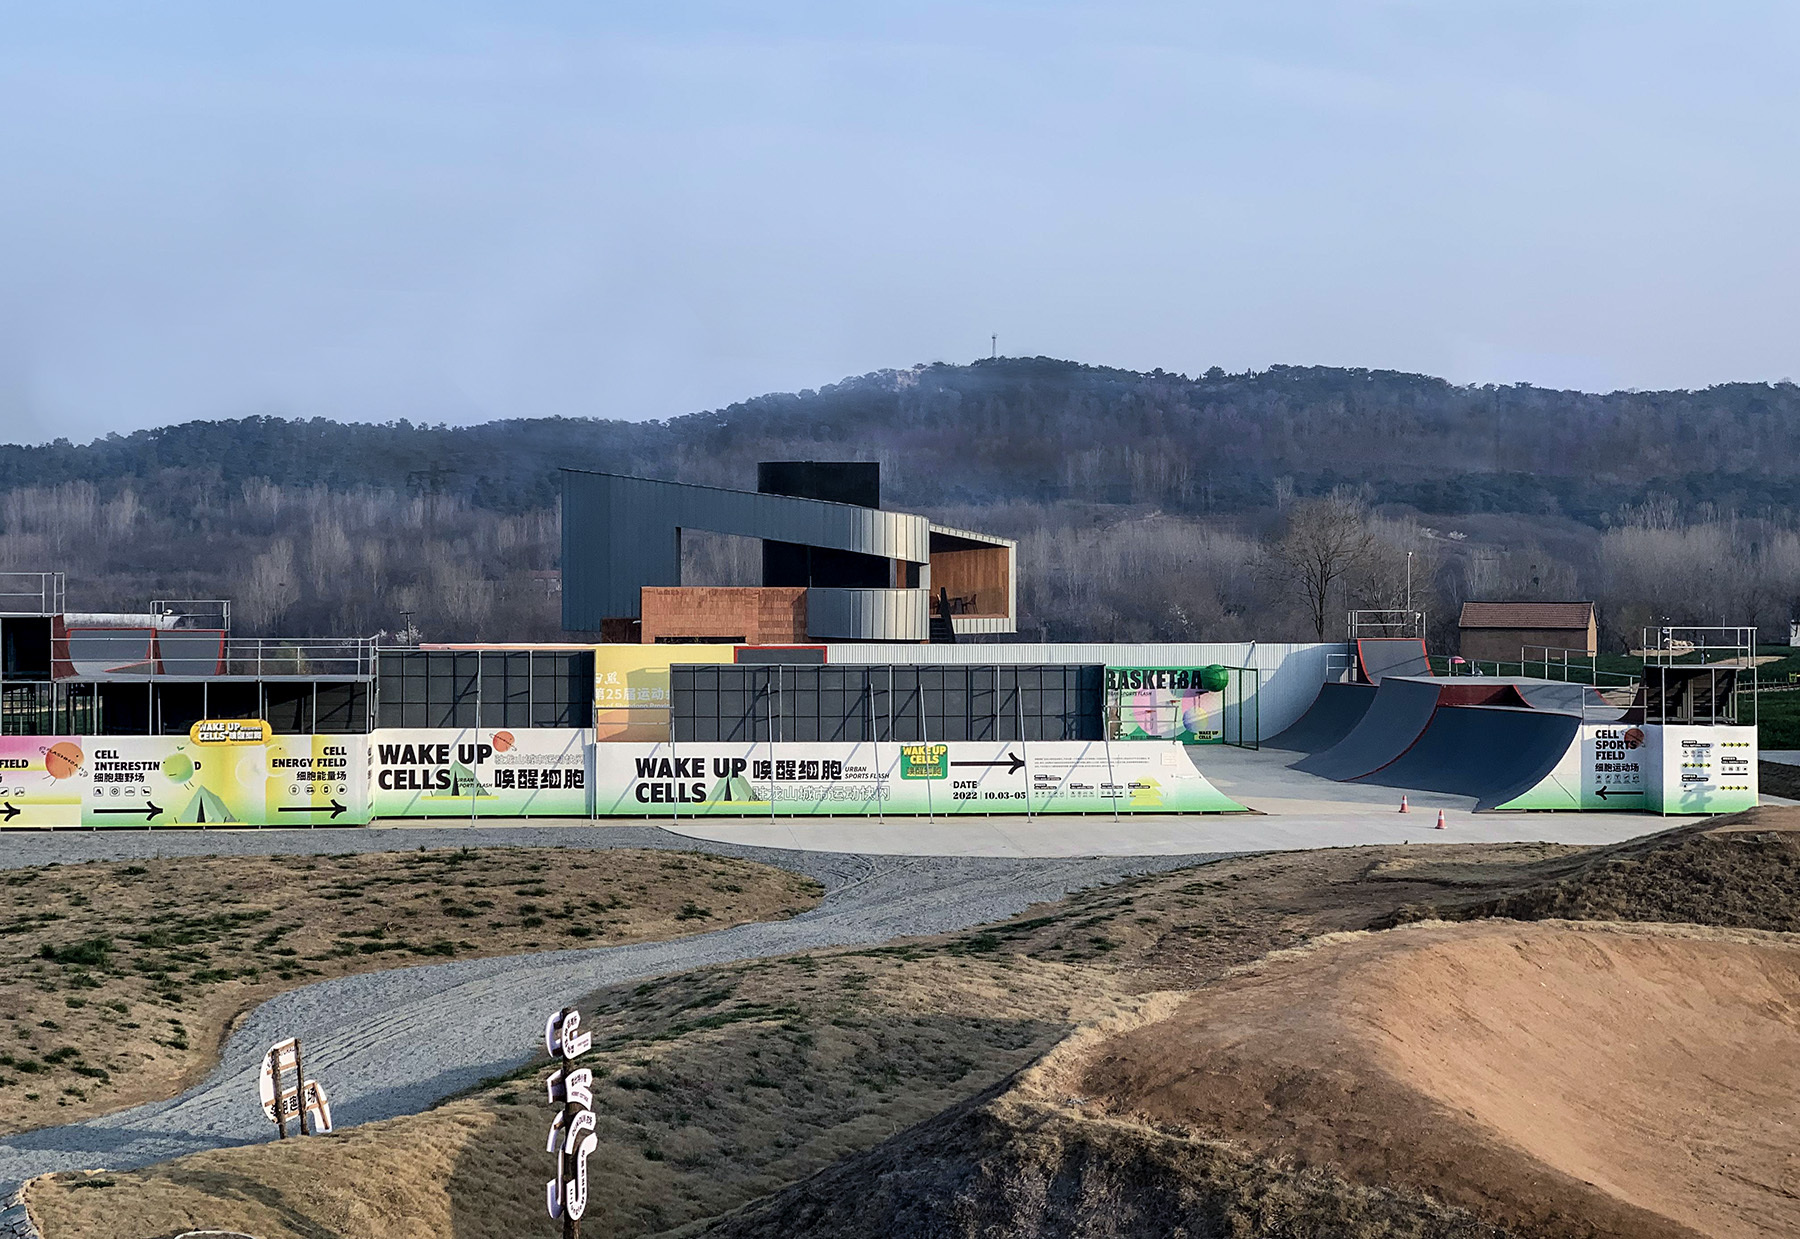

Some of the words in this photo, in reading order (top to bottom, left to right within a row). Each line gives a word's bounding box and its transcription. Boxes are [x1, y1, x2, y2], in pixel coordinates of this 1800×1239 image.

[1108, 670, 1204, 689] BASKETBA
[199, 723, 225, 732] WAKE
[228, 723, 241, 731] UP
[198, 732, 226, 741] CELLS
[1595, 730, 1619, 739] CELL
[1595, 740, 1637, 750] SPORTS
[94, 750, 119, 759] CELL
[323, 747, 347, 756] CELL
[378, 744, 449, 764] WAKE
[458, 744, 492, 764] UP
[903, 746, 932, 755] WAKE
[932, 746, 947, 755] UP
[910, 755, 939, 764] CELLS
[1595, 751, 1625, 760] FIELD
[0, 759, 29, 768] FIELD
[94, 761, 161, 771] INTERESTIN
[272, 759, 313, 768] ENERGY
[317, 759, 347, 768] FIELD
[635, 758, 705, 778] WAKE
[713, 758, 747, 778] UP
[1595, 763, 1640, 772] 细胞运动场
[752, 760, 842, 780] 唤醒细胞
[93, 773, 145, 783] 细胞趣野场
[296, 771, 347, 781] 细胞能量场
[378, 769, 451, 790] CELLS
[495, 769, 585, 789] 唤醒细胞
[953, 781, 978, 789] DATE
[635, 783, 706, 803] CELLS
[953, 791, 978, 800] 2022
[984, 791, 1027, 800] 10.03-05
